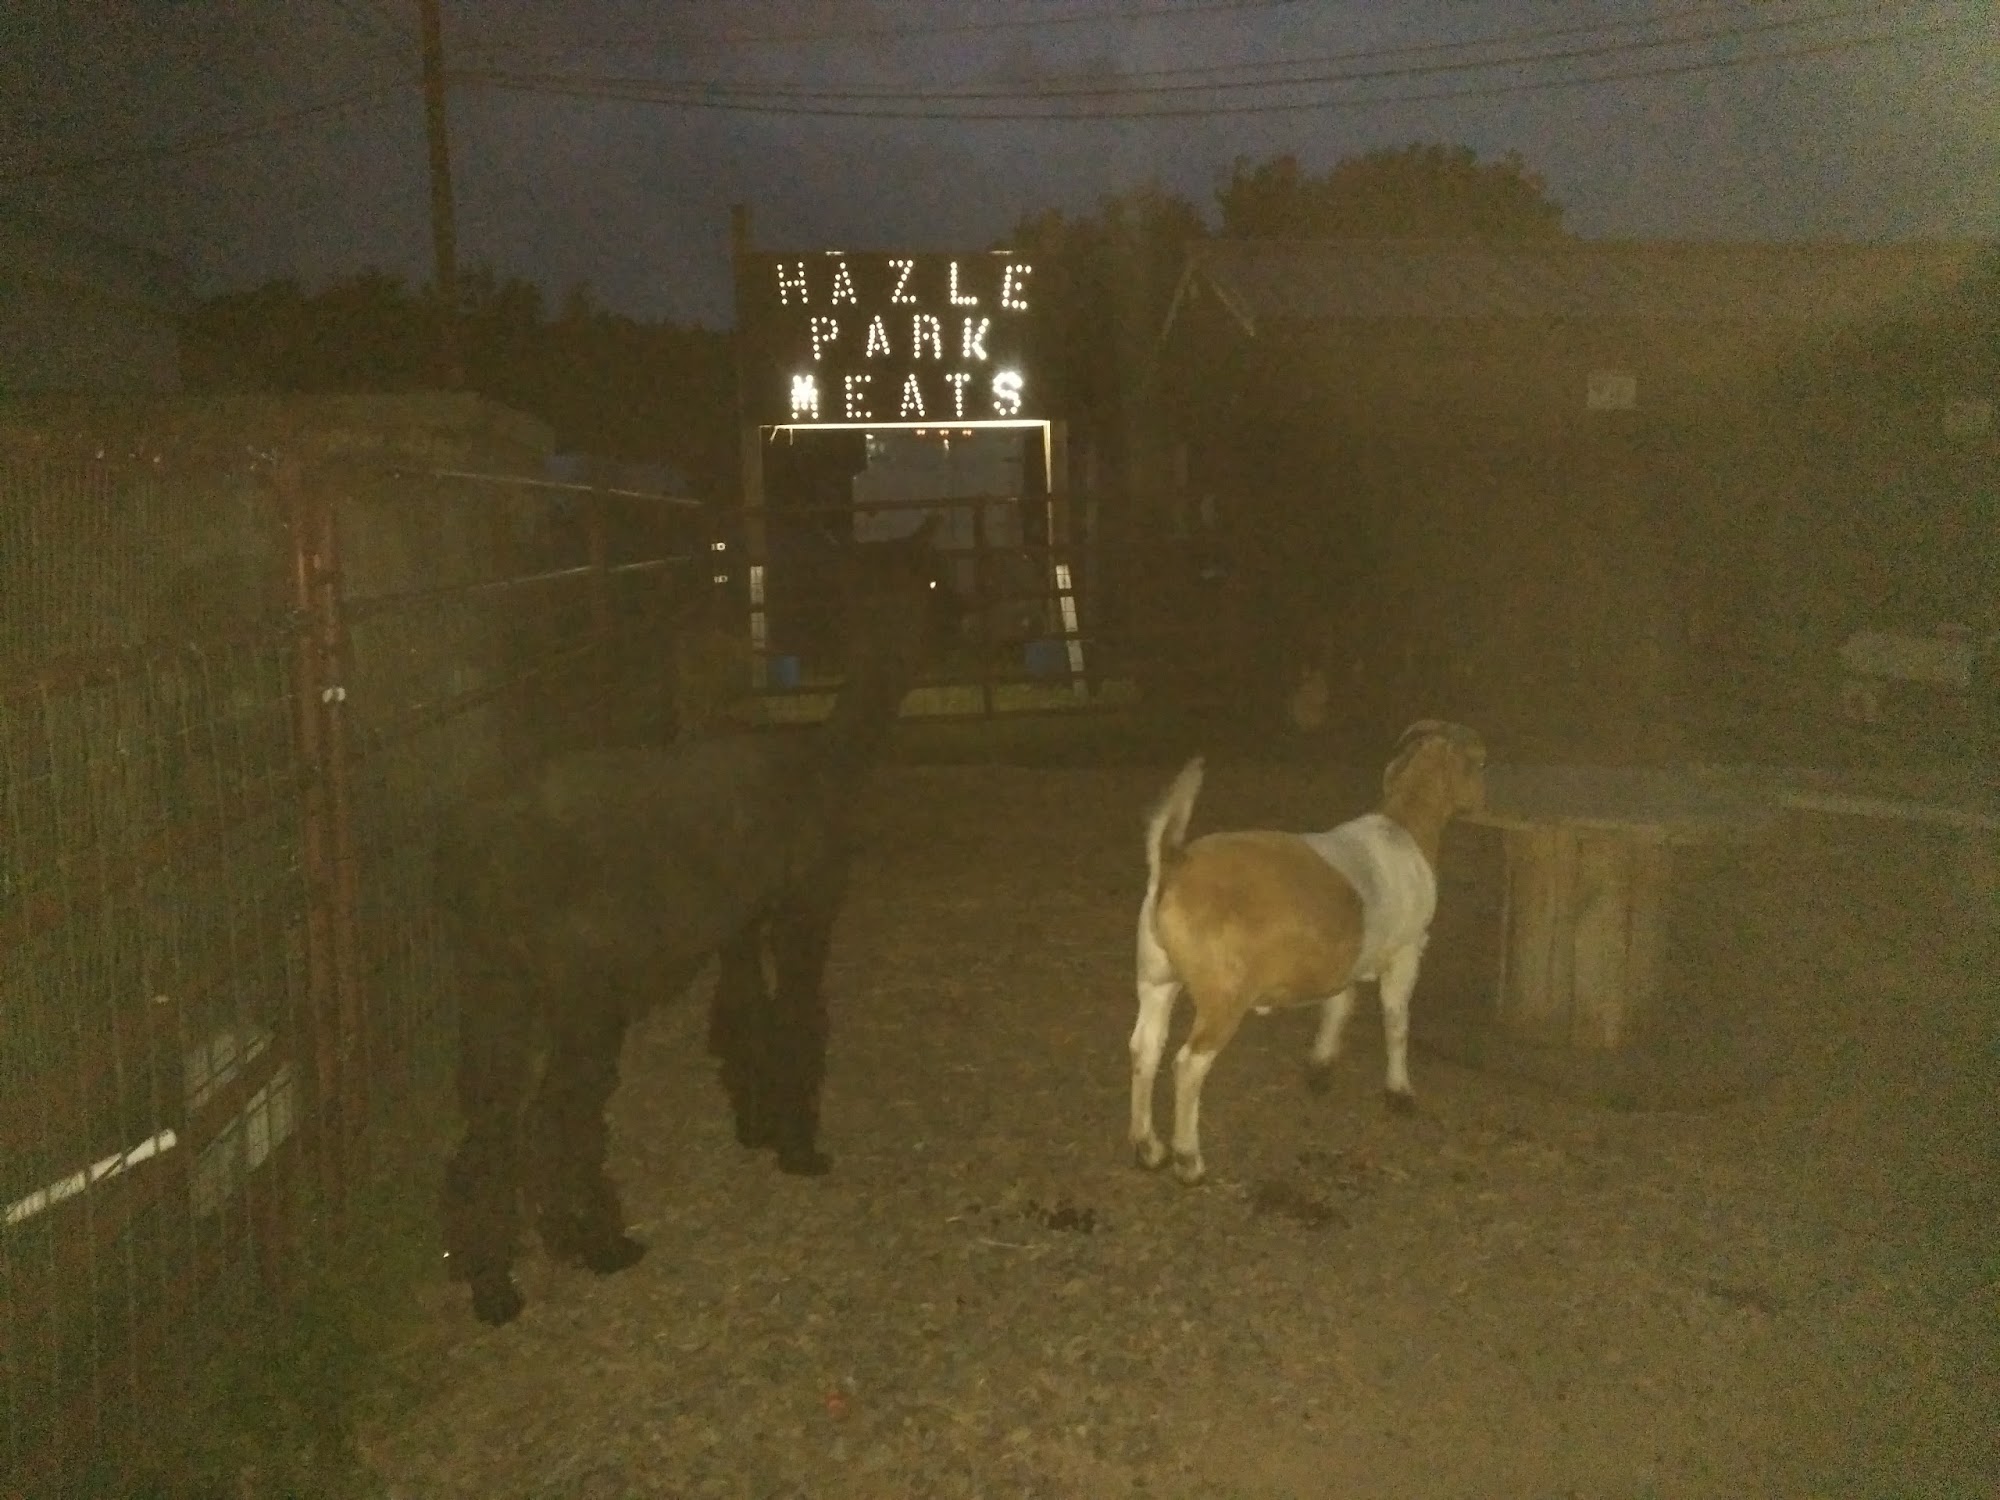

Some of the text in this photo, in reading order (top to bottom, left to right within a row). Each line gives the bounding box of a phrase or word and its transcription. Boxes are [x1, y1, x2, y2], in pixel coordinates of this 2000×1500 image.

[776, 260, 1032, 311] HAZLE
[810, 314, 989, 361] PARK
[790, 370, 1025, 420] MEATS
